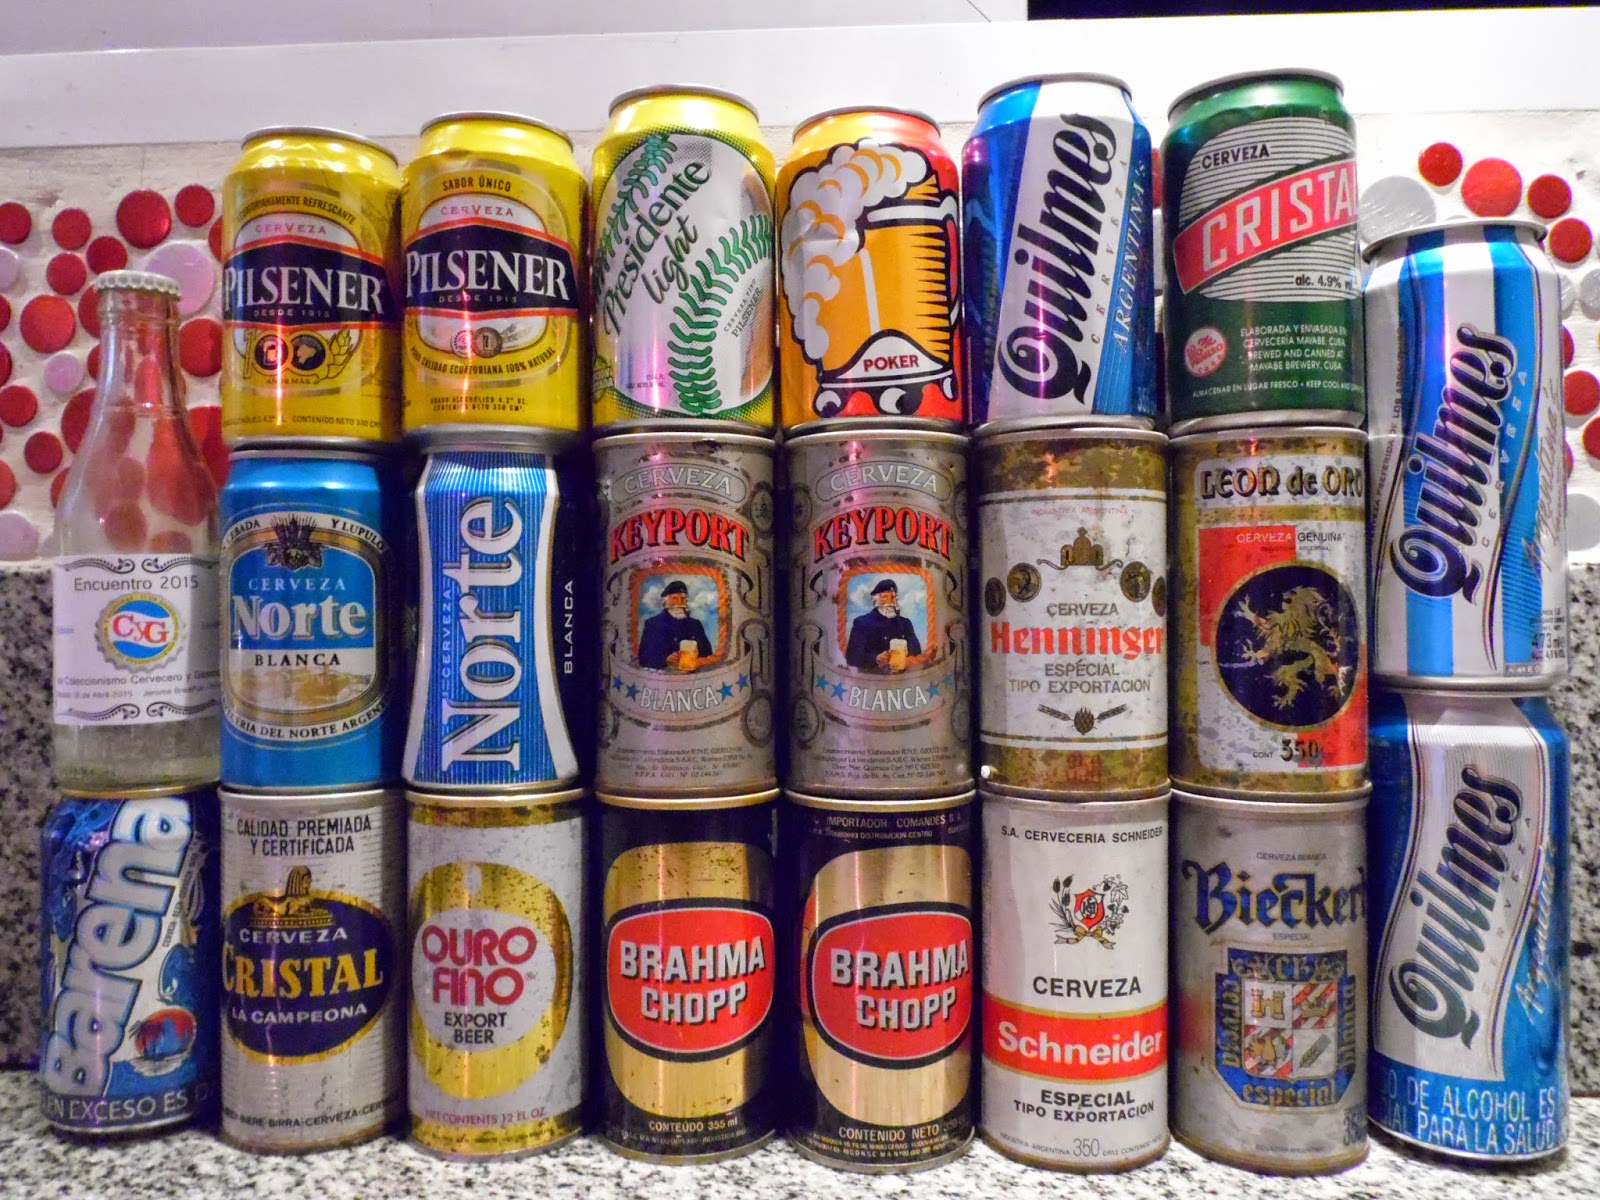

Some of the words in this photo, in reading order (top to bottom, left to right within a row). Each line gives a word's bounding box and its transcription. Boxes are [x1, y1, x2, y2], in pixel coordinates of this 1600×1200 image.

[1202, 144, 1271, 169] CERVEZA
[442, 178, 474, 193] SABOR
[478, 175, 512, 193] ÚNICO
[302, 196, 357, 226] REFRESCANTE
[440, 204, 514, 217] CERVEZA
[1202, 167, 1357, 273] CRISTA
[255, 223, 327, 235] CERVEZA
[602, 159, 711, 337] Presidente
[641, 212, 699, 305] light
[998, 112, 1118, 406] Quilmes
[1091, 159, 1128, 346] CERVEZA
[406, 249, 570, 301] PILSENER
[1295, 274, 1315, 287] alc.
[224, 266, 384, 314] PILSENER
[438, 294, 481, 304] DESDE
[253, 309, 294, 318] DESDE
[731, 287, 761, 338] PILSENER
[1240, 325, 1291, 337] ELABORADA
[1293, 325, 1300, 334] Y
[1300, 325, 1338, 334] ENVASADA
[1243, 335, 1295, 348] CERVECERÍA
[420, 358, 448, 373] CALIDAD
[449, 363, 503, 374] ECUATORIANA
[505, 361, 527, 374] 100%
[527, 346, 556, 369] NATURAL
[863, 354, 920, 373] POKER
[1247, 349, 1282, 360] BREWED
[1283, 349, 1302, 358] AND
[1303, 349, 1335, 358] CANNED
[1250, 361, 1284, 371] MAYABE
[1192, 385, 1232, 398] ALMACENAR
[1232, 384, 1243, 393] EN
[1243, 381, 1269, 391] LUGAR
[1270, 380, 1298, 389] FRESCO
[1305, 379, 1321, 389] KEEP
[1322, 380, 1340, 389] COOL
[292, 415, 335, 423] CONTENIDO
[336, 416, 355, 426] NETO
[1376, 439, 1395, 497] PREFERIDA
[1392, 401, 1402, 419] LOS
[1481, 370, 1528, 549] CERVEZA
[1390, 322, 1518, 605] Quilmes
[624, 467, 732, 497] CERVEZA
[830, 464, 938, 494] CERVEZA
[1286, 465, 1319, 496] de
[1322, 465, 1364, 498] ORO
[1080, 506, 1129, 516] ARGENTINA
[331, 519, 340, 528] Y
[341, 520, 384, 549] LUPULO
[611, 507, 750, 562] KEYPORT
[813, 505, 955, 565] KEYPORT
[1237, 532, 1293, 543] CERVEZA
[1297, 532, 1343, 542] GENUINA
[74, 577, 153, 592] Encuentro
[160, 575, 200, 590] 2015
[249, 577, 346, 591] CERVEZA
[232, 594, 367, 642] Norte
[1046, 603, 1119, 616] CERVEZA
[112, 613, 170, 644] CyG
[441, 496, 524, 772] Norte
[442, 589, 451, 679] CERVEZA
[563, 579, 575, 675] BLANCA
[990, 621, 1163, 660] Henninger
[254, 653, 342, 667] BLANCA
[130, 674, 183, 685] Cervecero
[1008, 679, 1041, 692] TIPO
[1048, 679, 1151, 693] EXPORTACION
[640, 683, 720, 714] BLANCA
[849, 683, 928, 713] BLANCA
[260, 726, 285, 738] DEL
[289, 724, 338, 739] NORTE
[1252, 751, 1274, 759] CONT
[1280, 738, 1320, 762] 350
[236, 818, 289, 837] CALIDAD
[297, 815, 372, 837] PREMIADA
[827, 815, 888, 828] IMPORTADOR
[896, 813, 946, 828] COMANDES
[251, 839, 259, 856] Y
[262, 836, 356, 857] CERTIFICADA
[1001, 825, 1019, 839] S.A.
[1024, 829, 1106, 844] CERVECERIA
[1112, 826, 1163, 843] SCHNEIDER
[1256, 852, 1296, 861] CERVEZA
[1388, 763, 1523, 1050] Quilmes
[44, 797, 195, 1098] Barena
[239, 927, 349, 944] CERVEZA
[421, 924, 538, 966] OURO
[1272, 932, 1312, 941] ESPECIAL
[222, 941, 384, 1000] CRISTAL
[620, 935, 766, 983] BRAHMA
[830, 939, 969, 989] BRAHMA
[432, 967, 525, 1007] FINO
[1032, 976, 1142, 999] CERVEZA
[232, 1006, 248, 1022] LA
[250, 1002, 368, 1024] CAMPEONA
[640, 981, 748, 1026] CHOPP
[855, 986, 957, 1033] CHOPP
[444, 1011, 508, 1029] EXPORT
[454, 1028, 495, 1045] BEER
[998, 1021, 1163, 1066] Schneider
[69, 1096, 157, 1121] EXCESO
[163, 1089, 188, 1113] ES
[1041, 1089, 1135, 1108] ESPECIAL
[1242, 1078, 1337, 1107] especial
[1406, 1076, 1431, 1111] DE
[1441, 1084, 1531, 1122] ALCOHOL
[1538, 1086, 1557, 1119] ES
[442, 1112, 498, 1126] CONTENTS
[501, 1112, 514, 1124] 12
[516, 1110, 528, 1120] FL
[530, 1107, 546, 1119] OZ
[1013, 1099, 1046, 1118] TIPO
[1053, 1101, 1154, 1123] EXPORTACION
[649, 1119, 704, 1133] CONTEÚDO
[707, 1119, 726, 1130] 355
[727, 1116, 738, 1127] ml
[838, 1126, 906, 1142] CONTENIDO
[912, 1123, 939, 1139] NETO
[1417, 1111, 1469, 1151] PARA
[1474, 1121, 1500, 1154] LA
[1503, 1119, 1557, 1155] SALUD
[1031, 1143, 1071, 1155] ARGENTINA
[1073, 1138, 1100, 1158] 350
